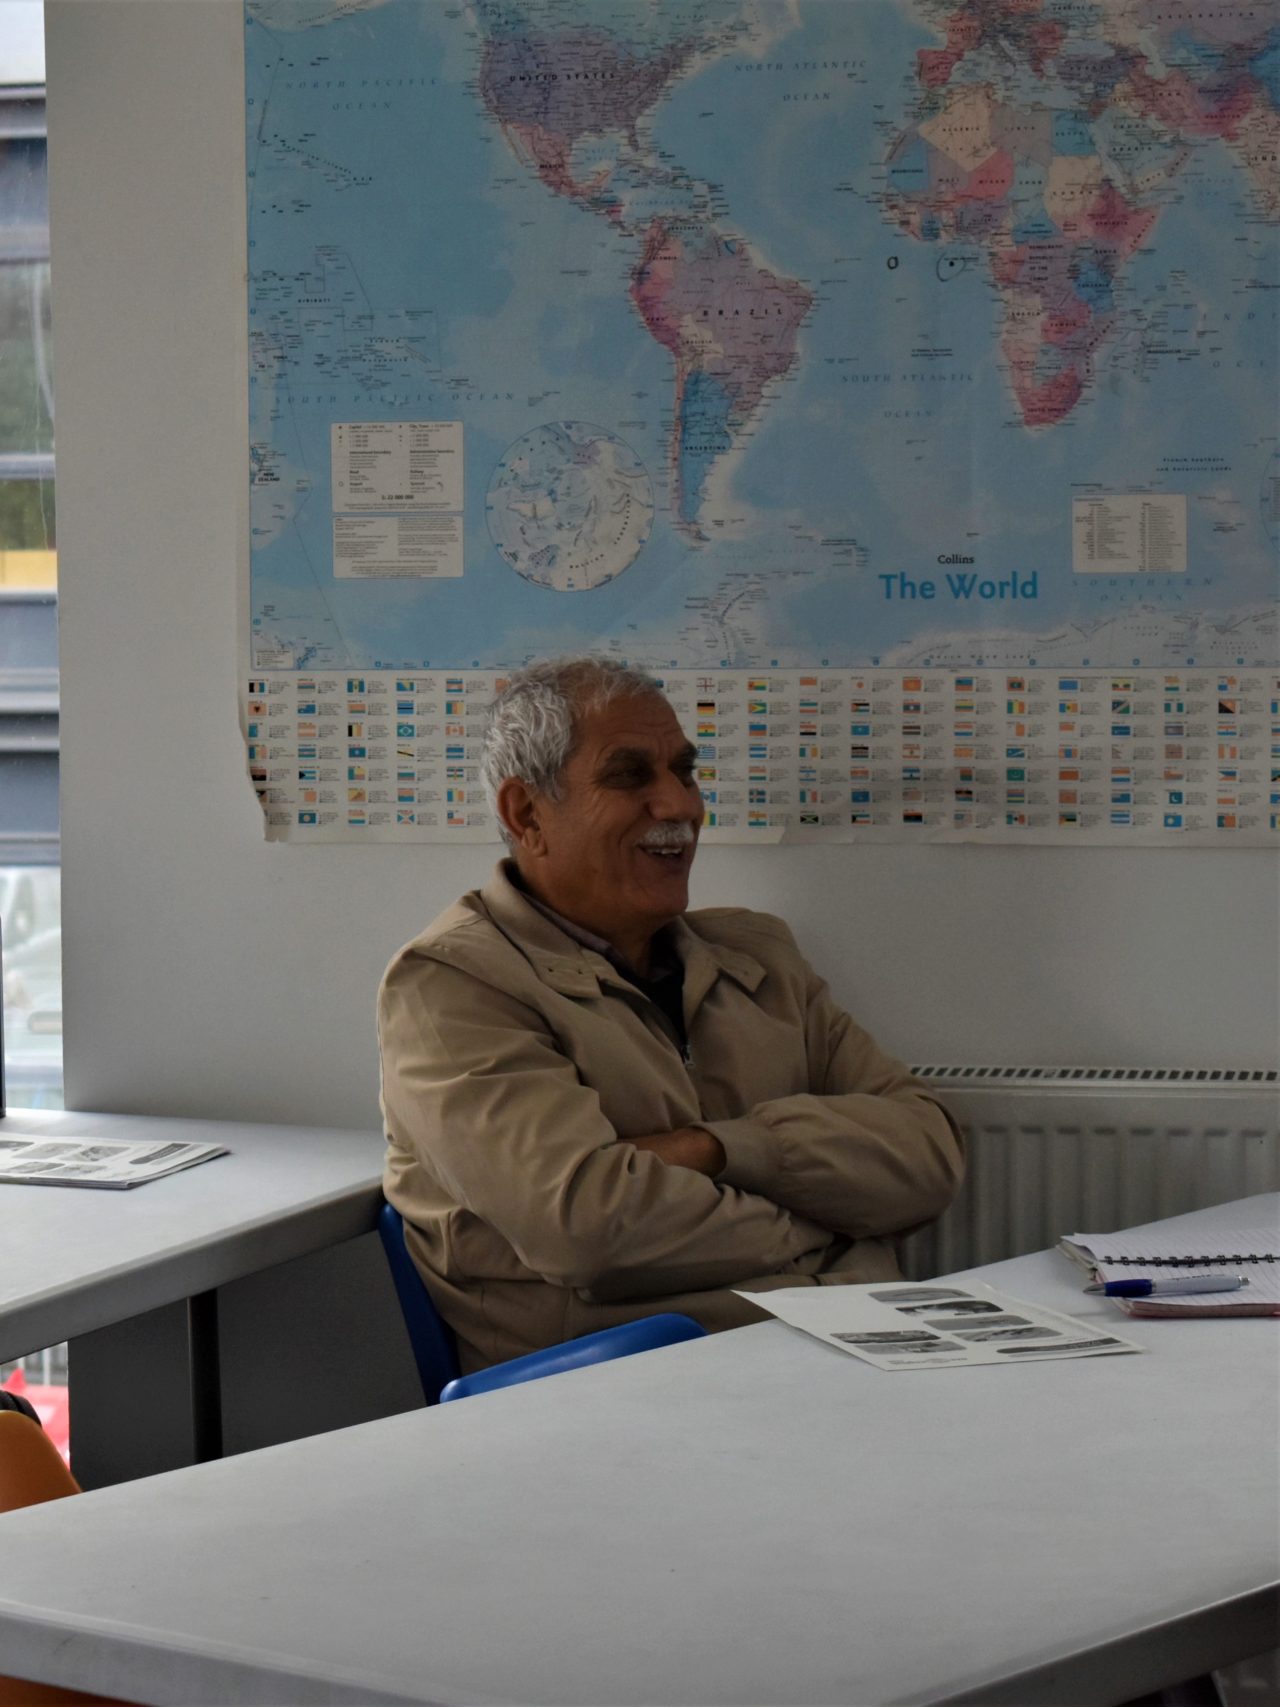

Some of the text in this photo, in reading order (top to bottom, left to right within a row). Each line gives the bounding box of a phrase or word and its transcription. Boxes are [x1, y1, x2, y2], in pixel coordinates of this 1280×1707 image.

[510, 72, 615, 82] UNITED STATES
[703, 308, 782, 317] BRAZIL
[937, 554, 975, 565] Collins
[878, 570, 1038, 599] The World
